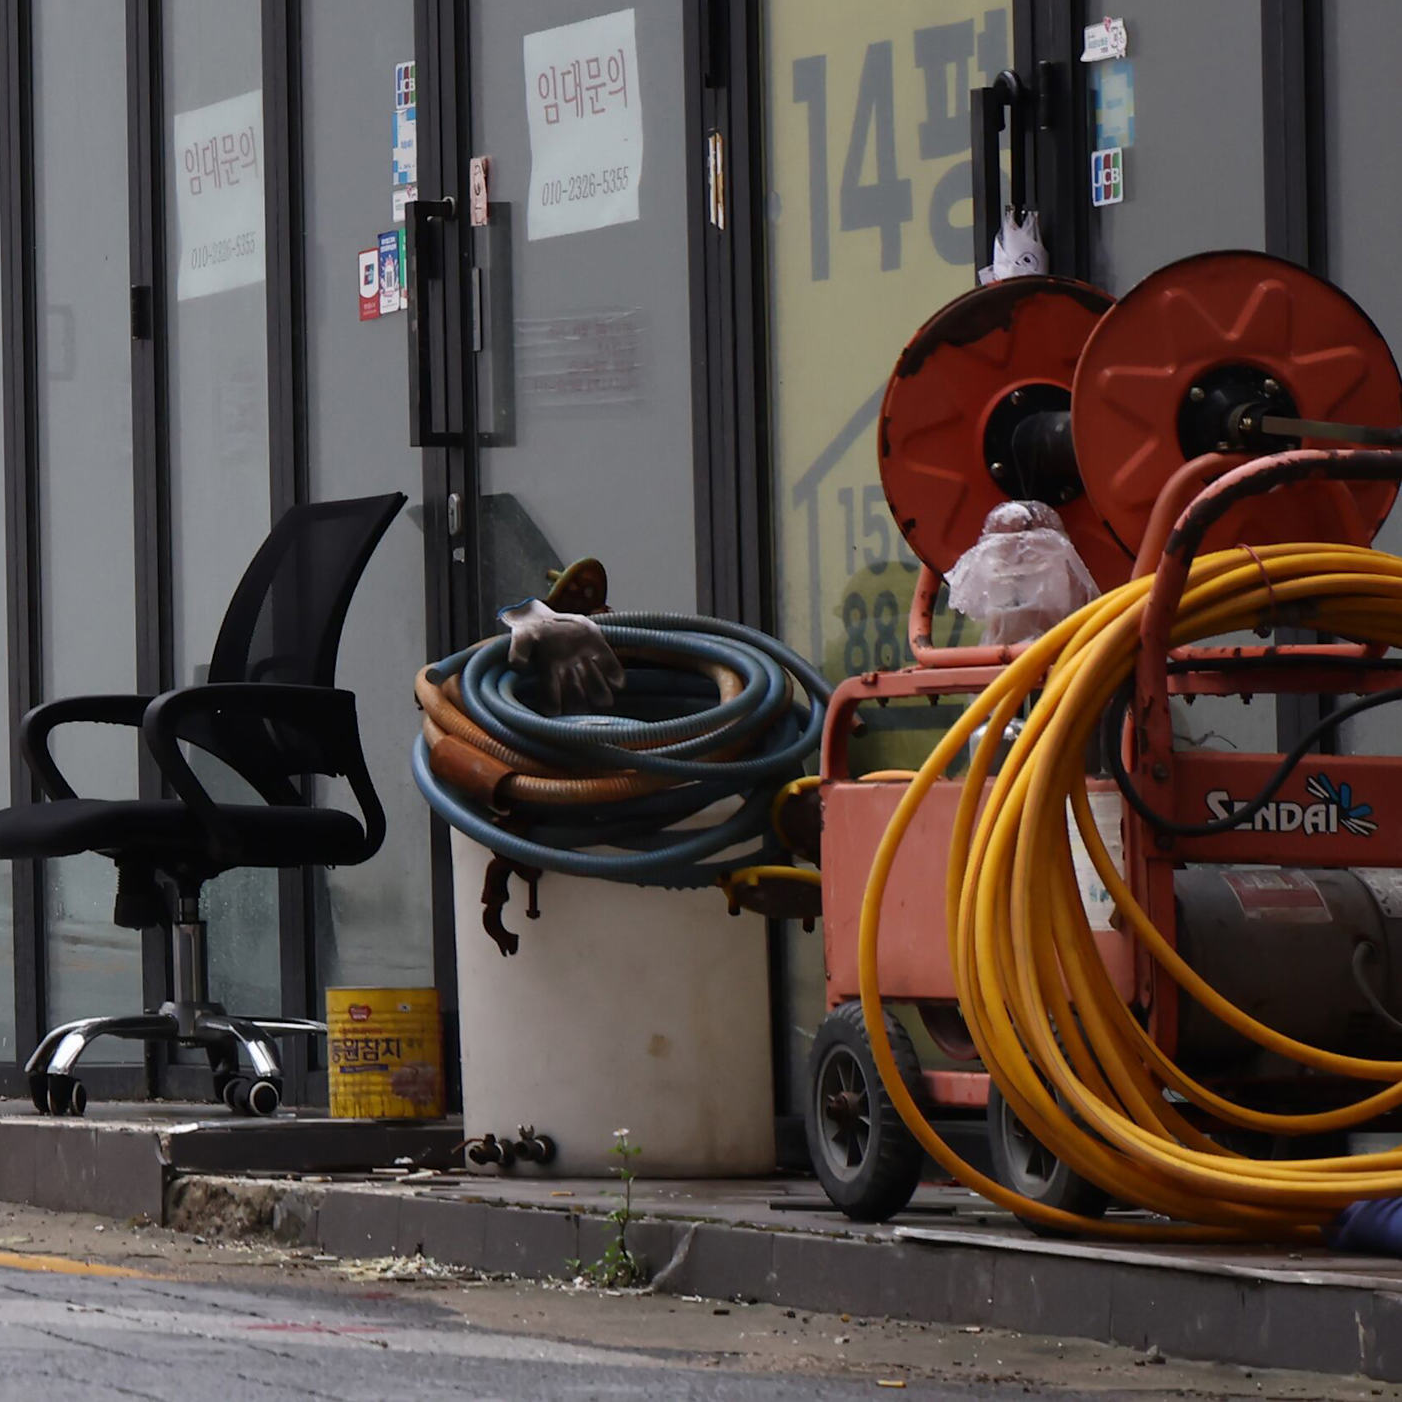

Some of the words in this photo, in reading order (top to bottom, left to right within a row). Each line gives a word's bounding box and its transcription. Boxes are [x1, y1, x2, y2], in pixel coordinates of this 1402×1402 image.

[537, 48, 629, 126] 임대문의
[184, 126, 260, 196] 임대문의
[541, 166, 630, 208] 010-2326-5355
[1094, 167, 1121, 187] JCB
